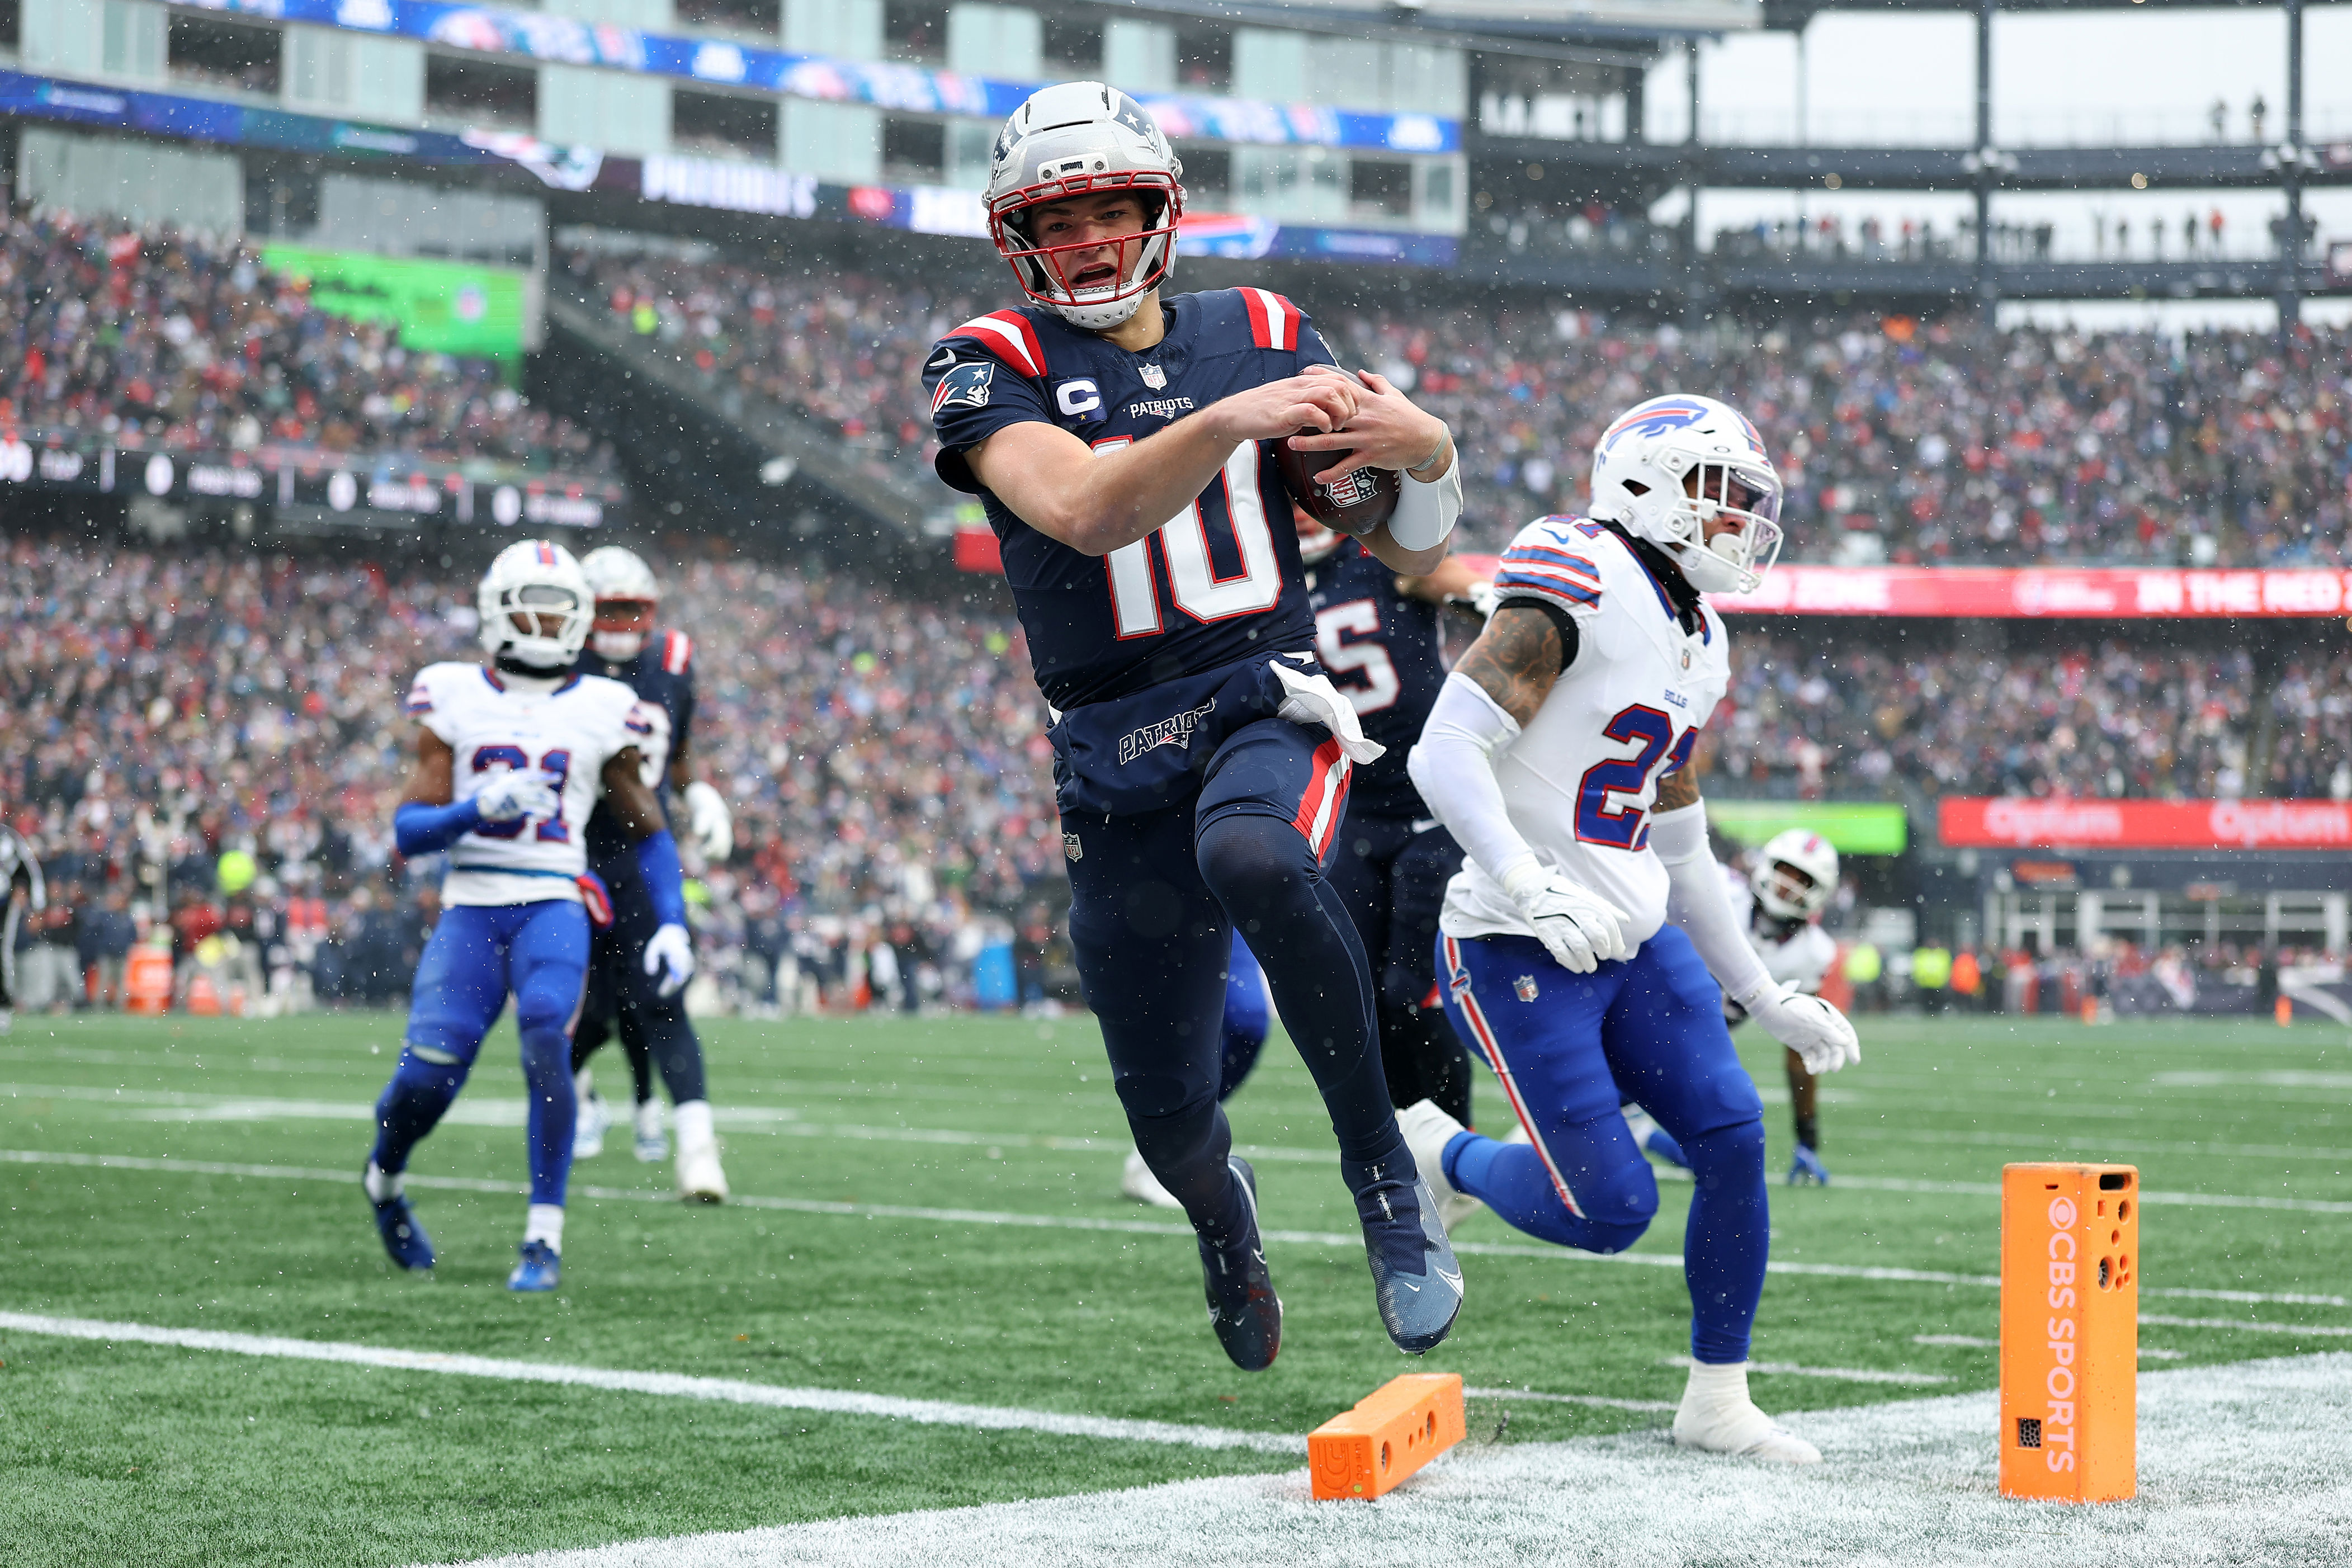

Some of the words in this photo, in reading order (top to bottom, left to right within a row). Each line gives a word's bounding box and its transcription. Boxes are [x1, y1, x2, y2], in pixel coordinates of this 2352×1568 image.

[1060, 161, 1084, 172] PATRIOTS
[1056, 380, 1101, 415] C
[1146, 375, 1163, 385] NFL
[1129, 396, 1194, 419] PATRIOTS
[1332, 475, 1358, 504] NFL
[1090, 434, 1283, 641] 10
[2186, 572, 2260, 613] THE
[1664, 688, 1688, 709] BILLS
[1983, 797, 2123, 846] Optum
[2209, 799, 2349, 848] Optum
[2047, 1232, 2077, 1309] CBS
[2047, 1317, 2075, 1473] SPORTS
